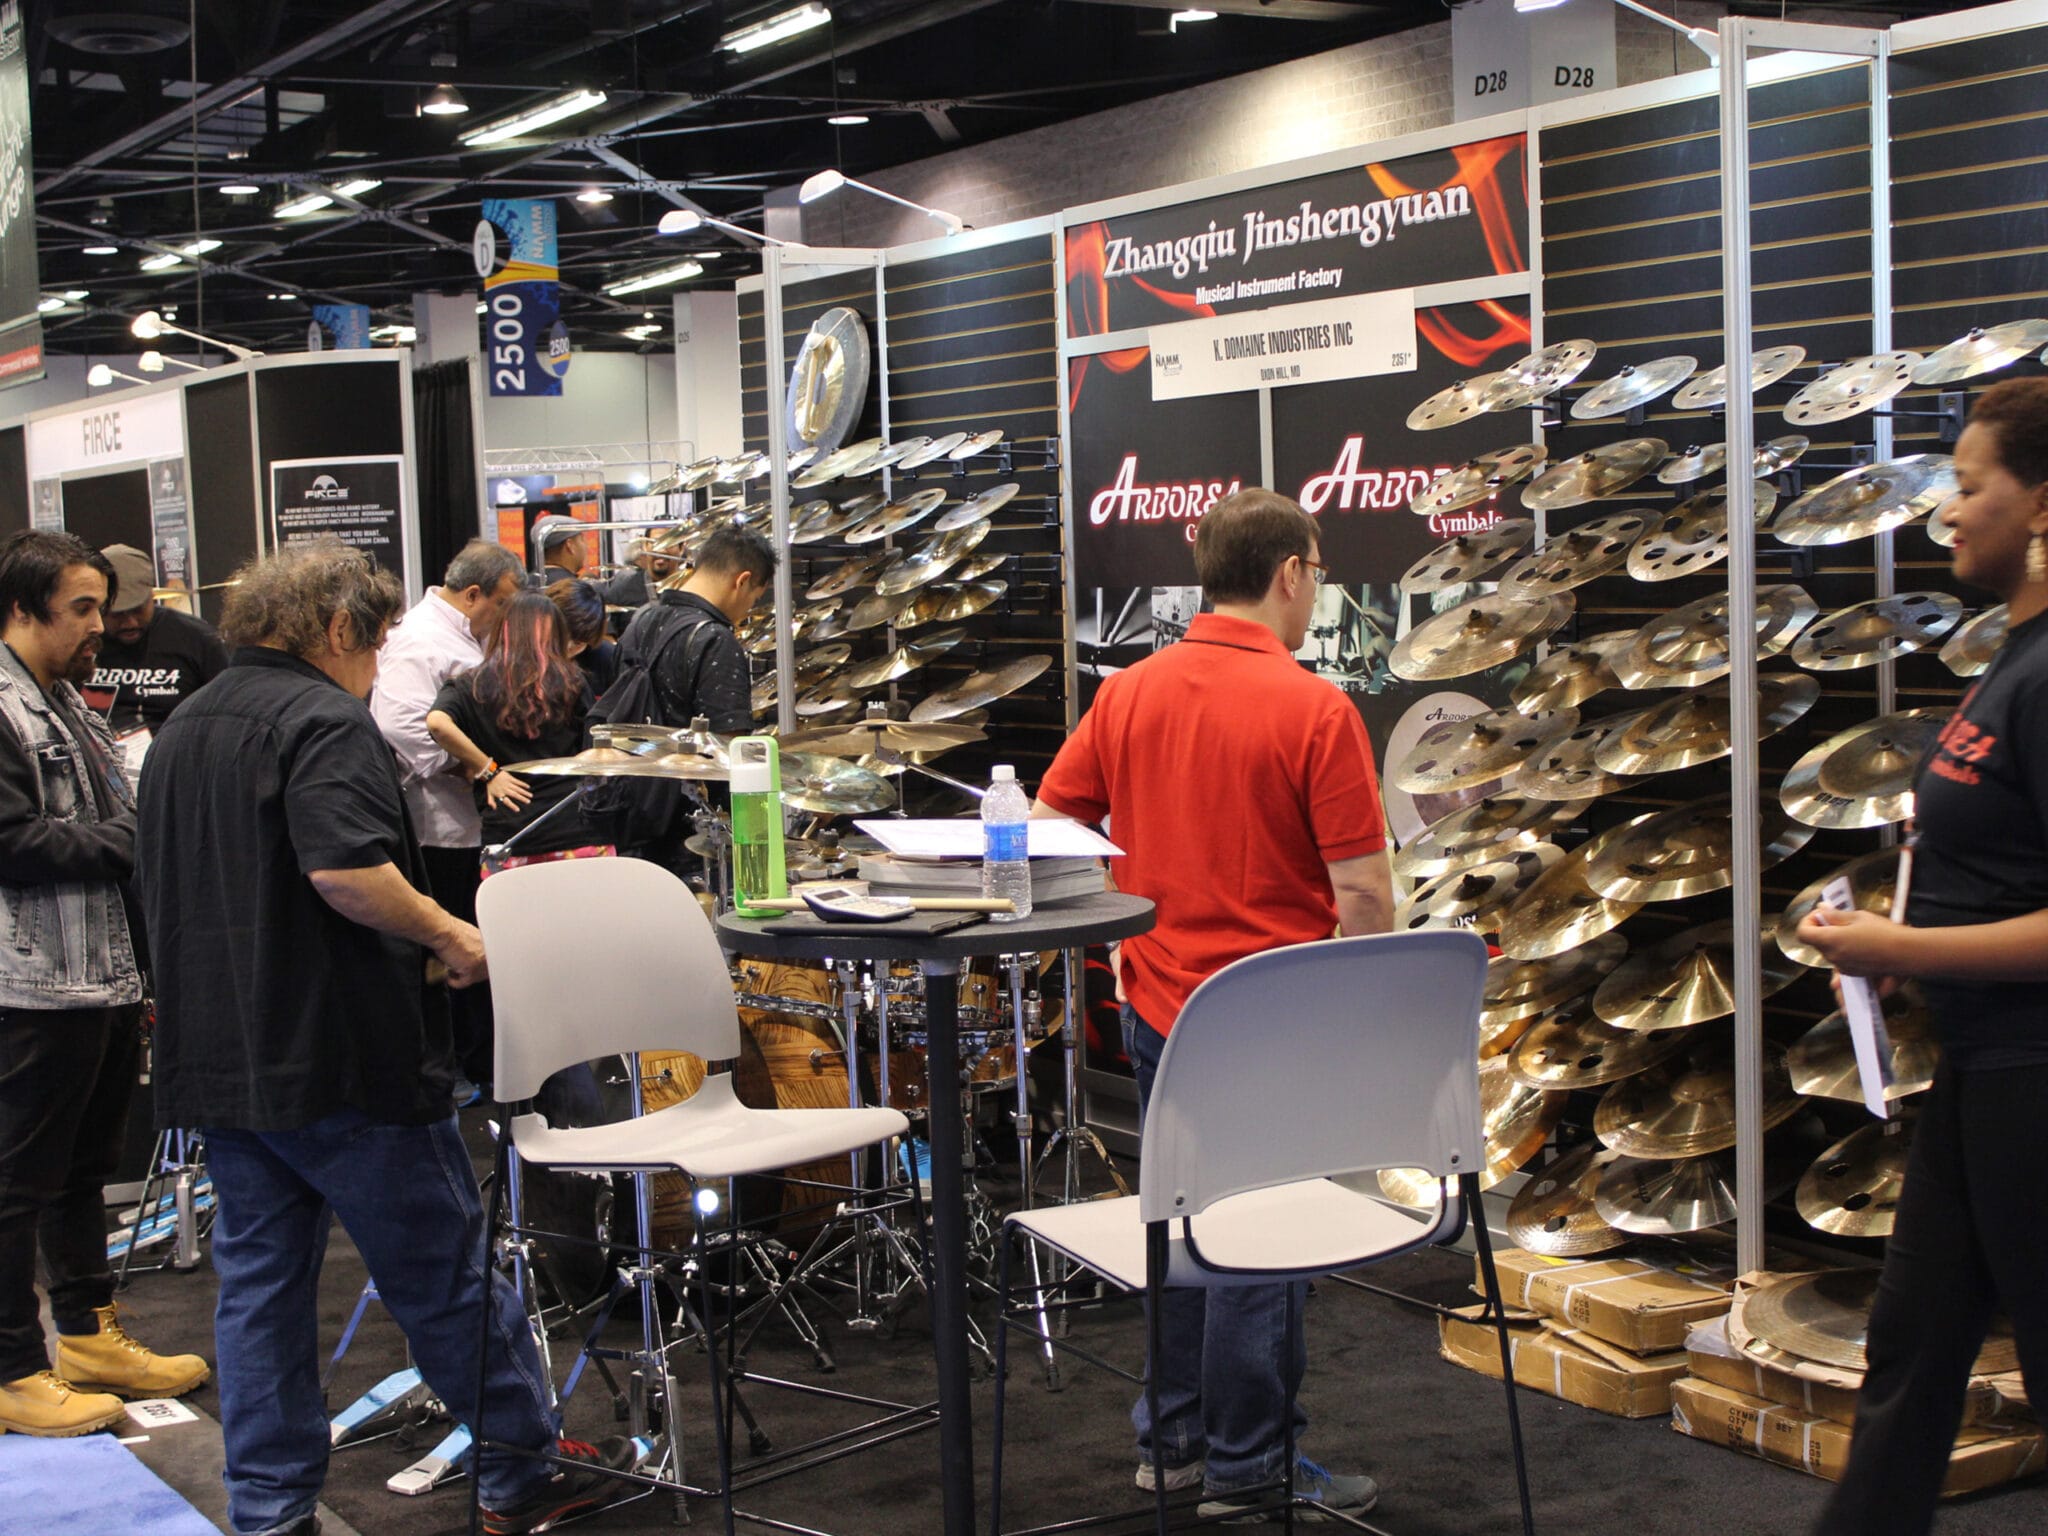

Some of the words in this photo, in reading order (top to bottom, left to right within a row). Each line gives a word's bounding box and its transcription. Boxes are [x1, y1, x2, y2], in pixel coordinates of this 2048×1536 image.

[1475, 70, 1507, 96] D28
[1555, 66, 1594, 88] D28
[1103, 219, 1237, 280] Zhangqiu
[1243, 184, 1471, 265] Jinshengyuan
[1195, 282, 1235, 306] Musical
[1236, 272, 1297, 300] Instrument
[1298, 268, 1343, 291] Factory
[493, 294, 525, 391] 2500
[550, 337, 571, 357] 2500
[1213, 339, 1224, 362] K.
[1224, 333, 1267, 360] DOMAINE
[1268, 327, 1331, 355] INDUSTRIES
[1333, 321, 1354, 347] INC
[1290, 365, 1301, 378] MD
[82, 411, 122, 457] FIRCE
[92, 668, 180, 685] RBOREA
